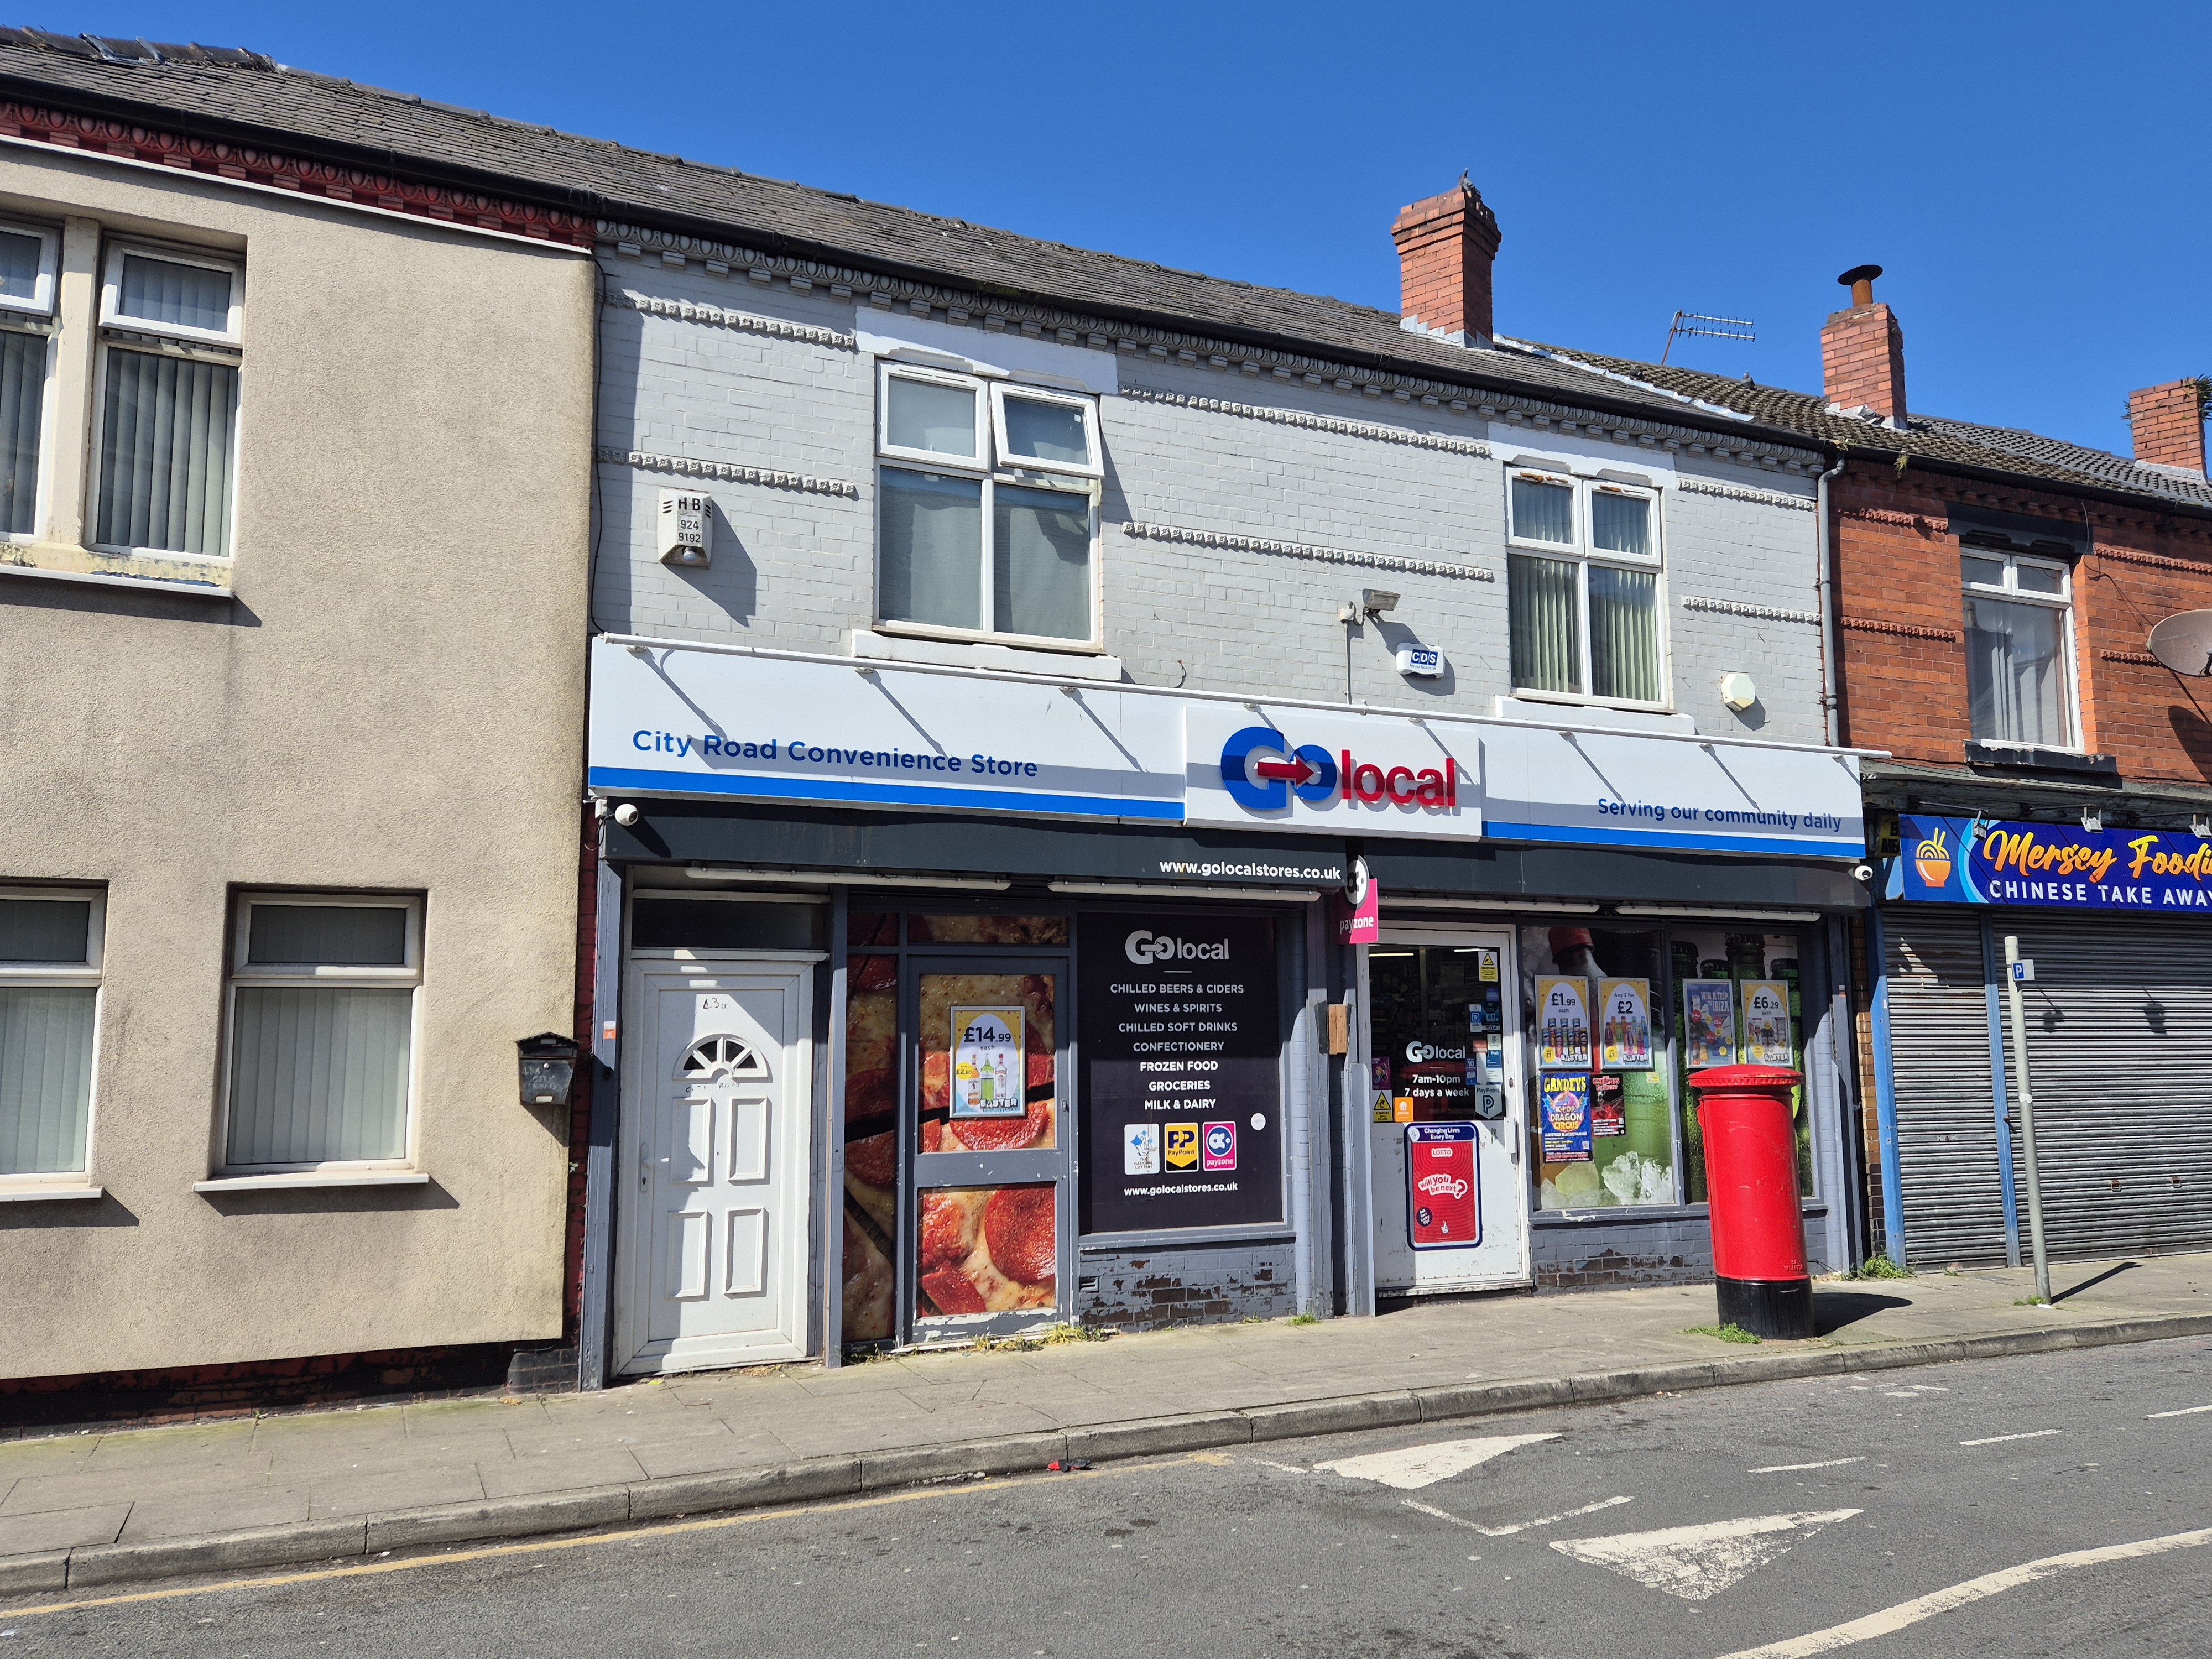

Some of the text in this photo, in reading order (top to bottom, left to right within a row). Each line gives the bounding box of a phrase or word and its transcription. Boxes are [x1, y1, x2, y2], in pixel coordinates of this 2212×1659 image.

[681, 520, 698, 530] 924
[679, 533, 701, 542] 9192
[1412, 652, 1436, 664] CDS
[633, 730, 1038, 778] City Road Convenience Store
[1598, 798, 1842, 832] Serving our community daily
[1983, 830, 2212, 883] Mersey Foodi
[1160, 860, 1342, 880] www.golocalstores.co.uk
[1990, 880, 2088, 901] CHINESE
[2098, 885, 2152, 904] TAKE
[1340, 916, 1374, 935] payzone
[2015, 964, 2023, 978] P
[1110, 984, 1244, 994] CHILLED BEERS & CIDERS
[1551, 993, 1576, 1006] £1.99
[1701, 992, 1712, 1000] WIN
[1134, 1003, 1222, 1013] WINES & SPIRITS
[1618, 1000, 1634, 1014] £2
[1712, 1001, 1730, 1011] IBIZA
[1754, 996, 1779, 1009] £6.29
[1118, 1022, 1238, 1032] CHILLED SOFT DRINKS
[964, 1026, 1011, 1042] £14.99
[1133, 1042, 1224, 1052] CONFECTIONERY
[1561, 1053, 1588, 1062] EASTER
[1623, 1053, 1648, 1062] EASTER
[1764, 1053, 1789, 1061] EASTER
[1140, 1061, 1218, 1072] FROZEN FOOD
[1412, 1074, 1460, 1086] 7am-10pm
[1544, 1076, 1586, 1093] GANDEYS
[1149, 1081, 1211, 1091] GROCERIES
[1404, 1087, 1410, 1097] 7
[1412, 1087, 1434, 1098] days
[1445, 1087, 1469, 1097] week
[980, 1097, 1018, 1108] EASTER
[1144, 1099, 1216, 1110] MILK & DAIRY
[1550, 1113, 1583, 1122] DRAGON
[1206, 1158, 1234, 1167] payzone
[1420, 1175, 1449, 1188] will you
[1124, 1182, 1238, 1196] www.golocalstores.co.uk
